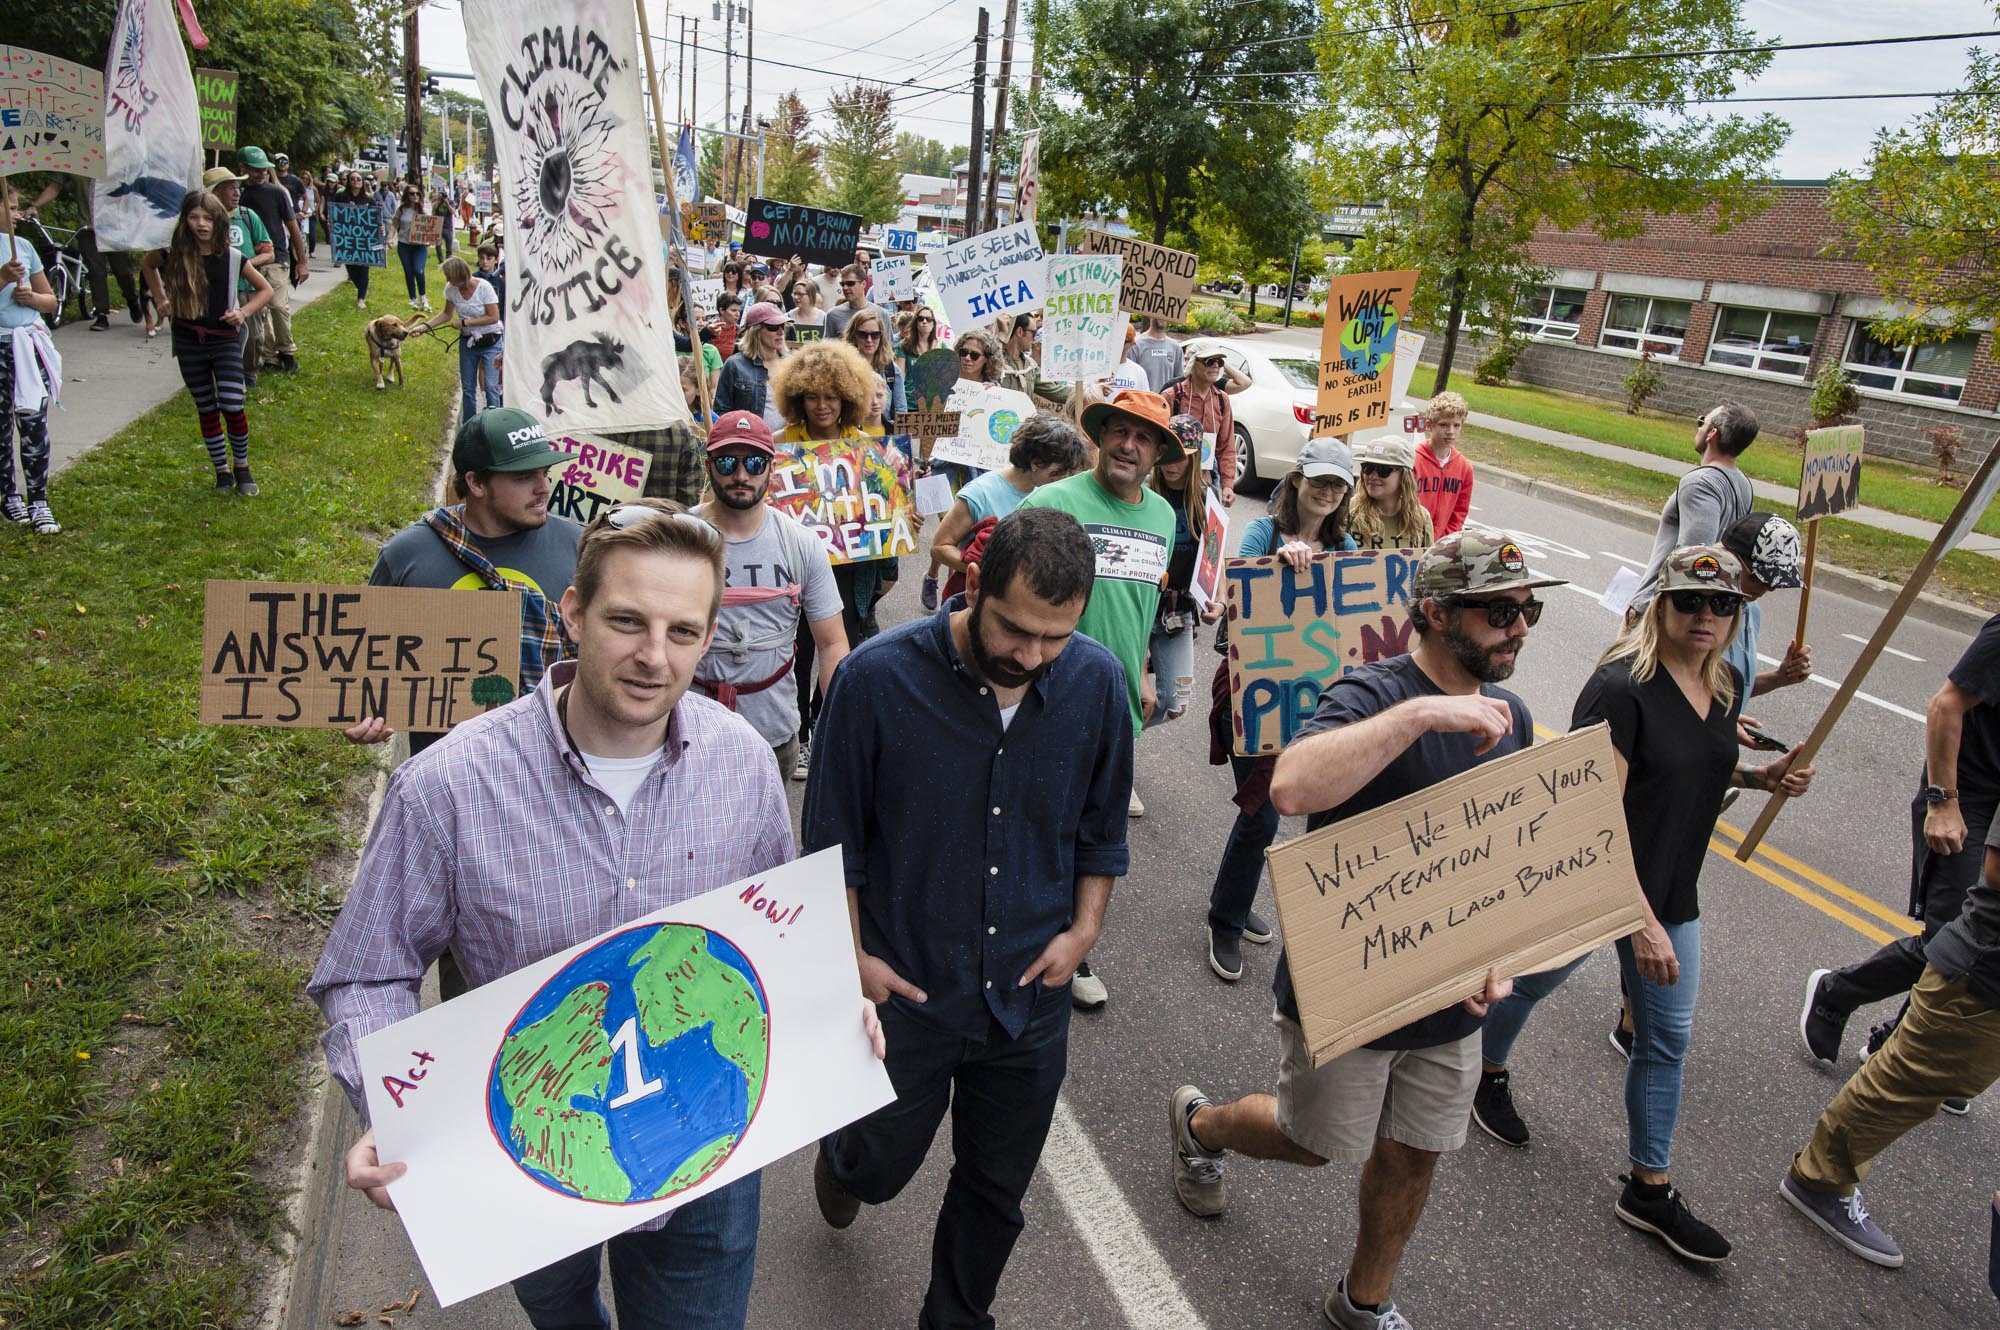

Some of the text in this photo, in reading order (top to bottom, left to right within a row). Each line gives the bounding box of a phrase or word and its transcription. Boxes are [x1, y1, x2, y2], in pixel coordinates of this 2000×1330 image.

[195, 73, 237, 105] HOW
[500, 24, 628, 132] CLIMATE
[333, 206, 378, 227] MAKE
[698, 206, 719, 217] THIS
[762, 204, 795, 220] GET
[800, 208, 809, 223] A
[816, 212, 853, 232] BRAIN
[333, 223, 378, 239] SNOW
[334, 235, 379, 251] DEEP
[705, 230, 726, 239] FINE
[772, 222, 856, 254] MORANS!
[888, 232, 913, 251] 2.79
[334, 249, 381, 264] AGAIN!
[942, 228, 1031, 270] I'VE SEEN
[1090, 231, 1197, 279] WATERWORLD
[876, 258, 906, 273] EARTH
[937, 246, 1043, 293] SMARTER CABINETS
[1054, 261, 1121, 289] WITHOUT
[511, 234, 643, 326] JUSTICE
[981, 273, 999, 289] AT
[1150, 271, 1165, 295] A
[968, 279, 1034, 318] IKEA
[1046, 292, 1115, 317] SCIENCE
[1339, 287, 1403, 322] WAKE
[1077, 316, 1110, 341] JUST
[1353, 321, 1385, 345] UP!!
[1324, 352, 1379, 373] THERE IS
[1324, 369, 1379, 392] NO SECOND
[1347, 381, 1382, 399] EARTH!
[896, 413, 912, 424] IF
[922, 423, 959, 436] RUINED
[1315, 401, 1387, 434] THIS IS IT!
[562, 463, 598, 488] for
[1804, 452, 1851, 484] MOUNTAINS
[1415, 476, 1441, 494] OLD
[547, 478, 622, 525] ART
[816, 515, 917, 560] RETA
[1101, 526, 1158, 543] CLIMATE PATRIOT
[1100, 567, 1120, 576] FIGHT
[1128, 569, 1157, 581] PROTECT
[249, 592, 366, 640] THE
[212, 630, 499, 675] ANSWER IS
[1241, 619, 1342, 680] IS
[222, 676, 466, 729] IS IN THE
[1306, 843, 1390, 897] WILL
[1462, 786, 1526, 830] HAVE
[1537, 759, 1604, 805] YOUR
[1340, 811, 1549, 930] ATTENTION IF
[1363, 828, 1615, 971] MARA LAGO BURNS?
[608, 1015, 664, 1110] 1
[381, 1048, 436, 1109] Act
